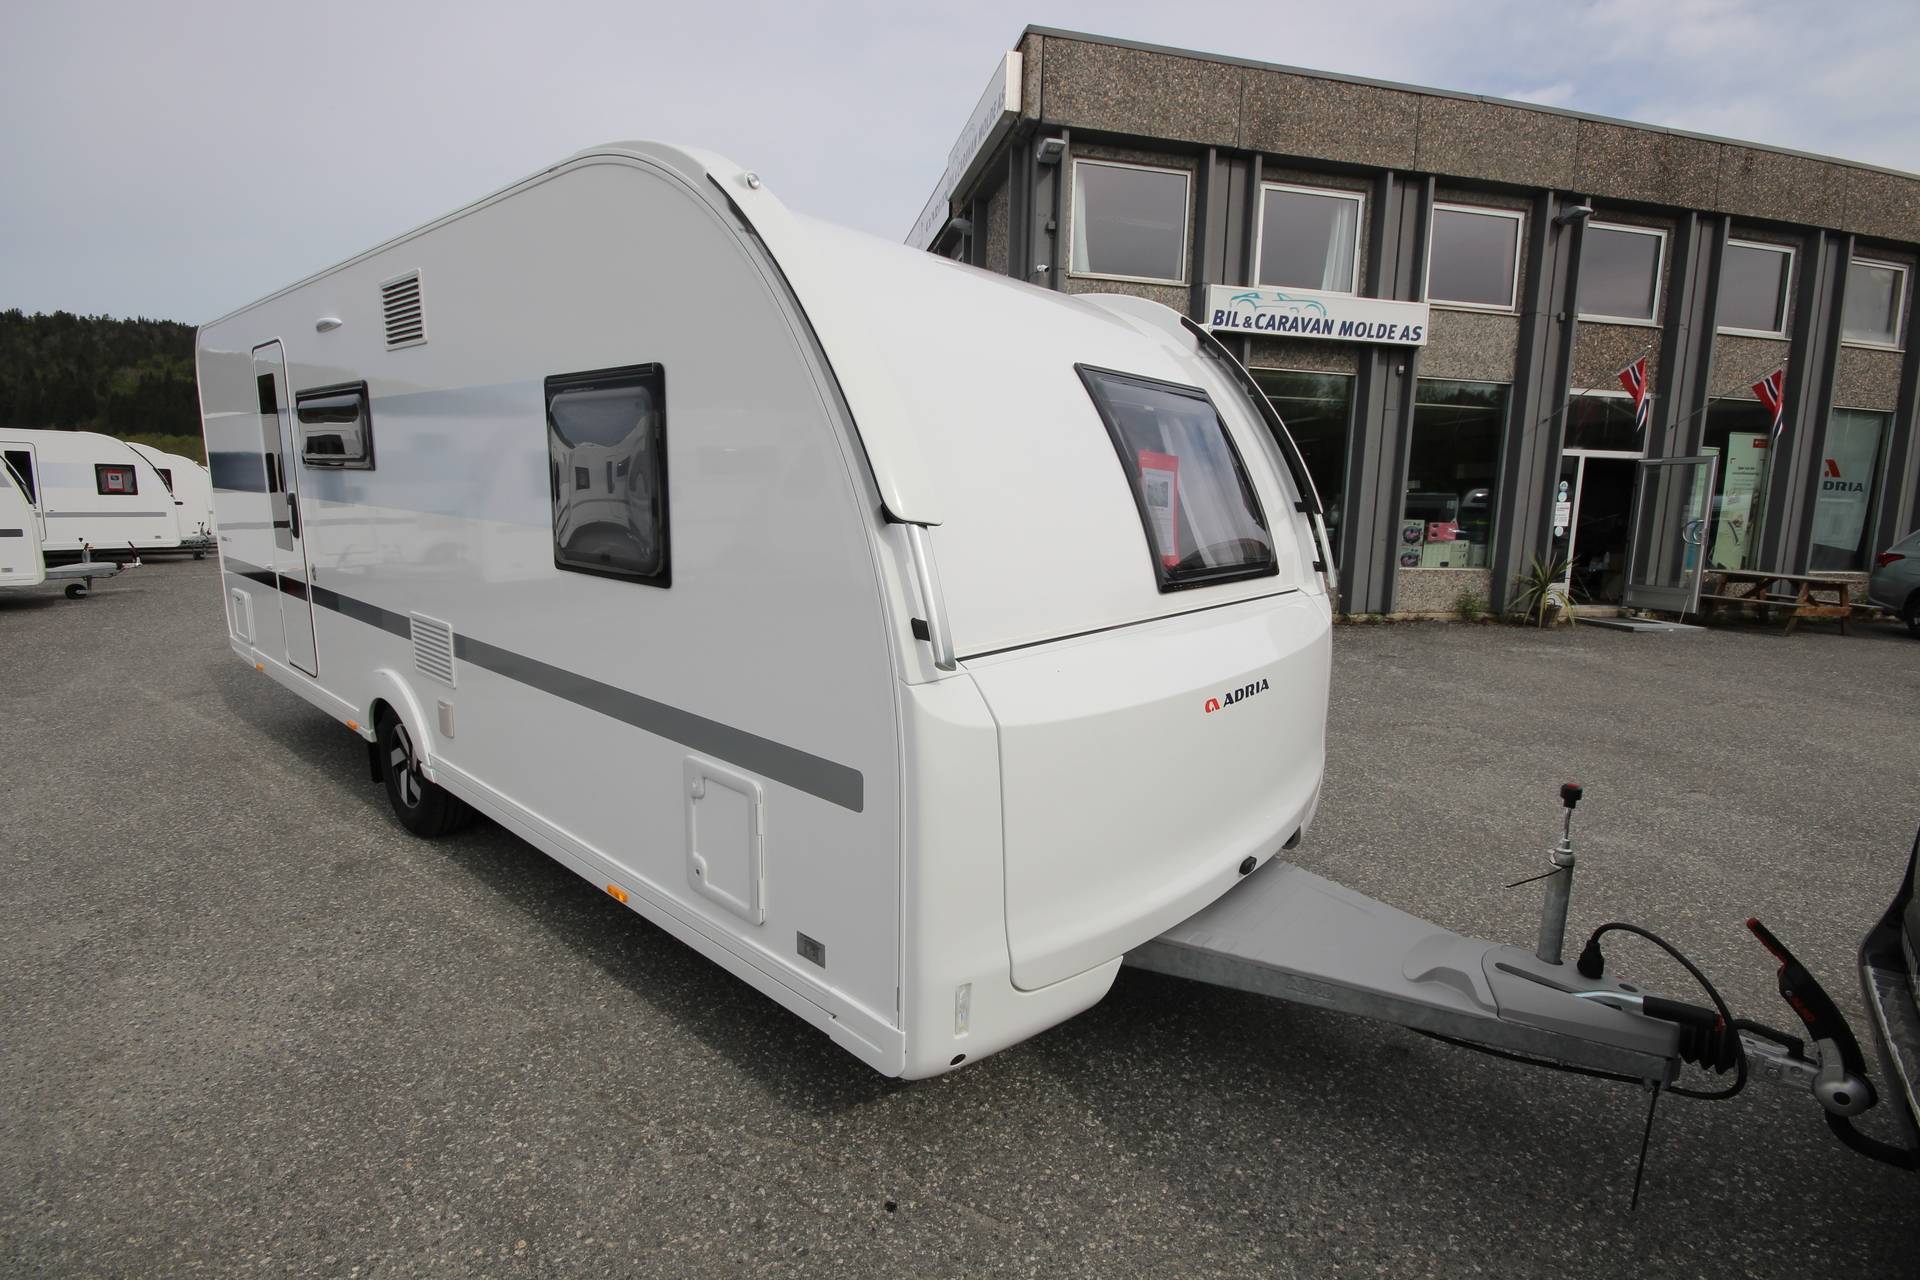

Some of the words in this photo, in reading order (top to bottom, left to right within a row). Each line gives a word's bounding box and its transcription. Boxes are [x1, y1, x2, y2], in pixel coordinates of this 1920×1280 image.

[1212, 309, 1239, 328] BIL
[1338, 320, 1398, 340] MOLDE
[1398, 324, 1423, 342] AS
[1223, 678, 1270, 708] ADRIA
